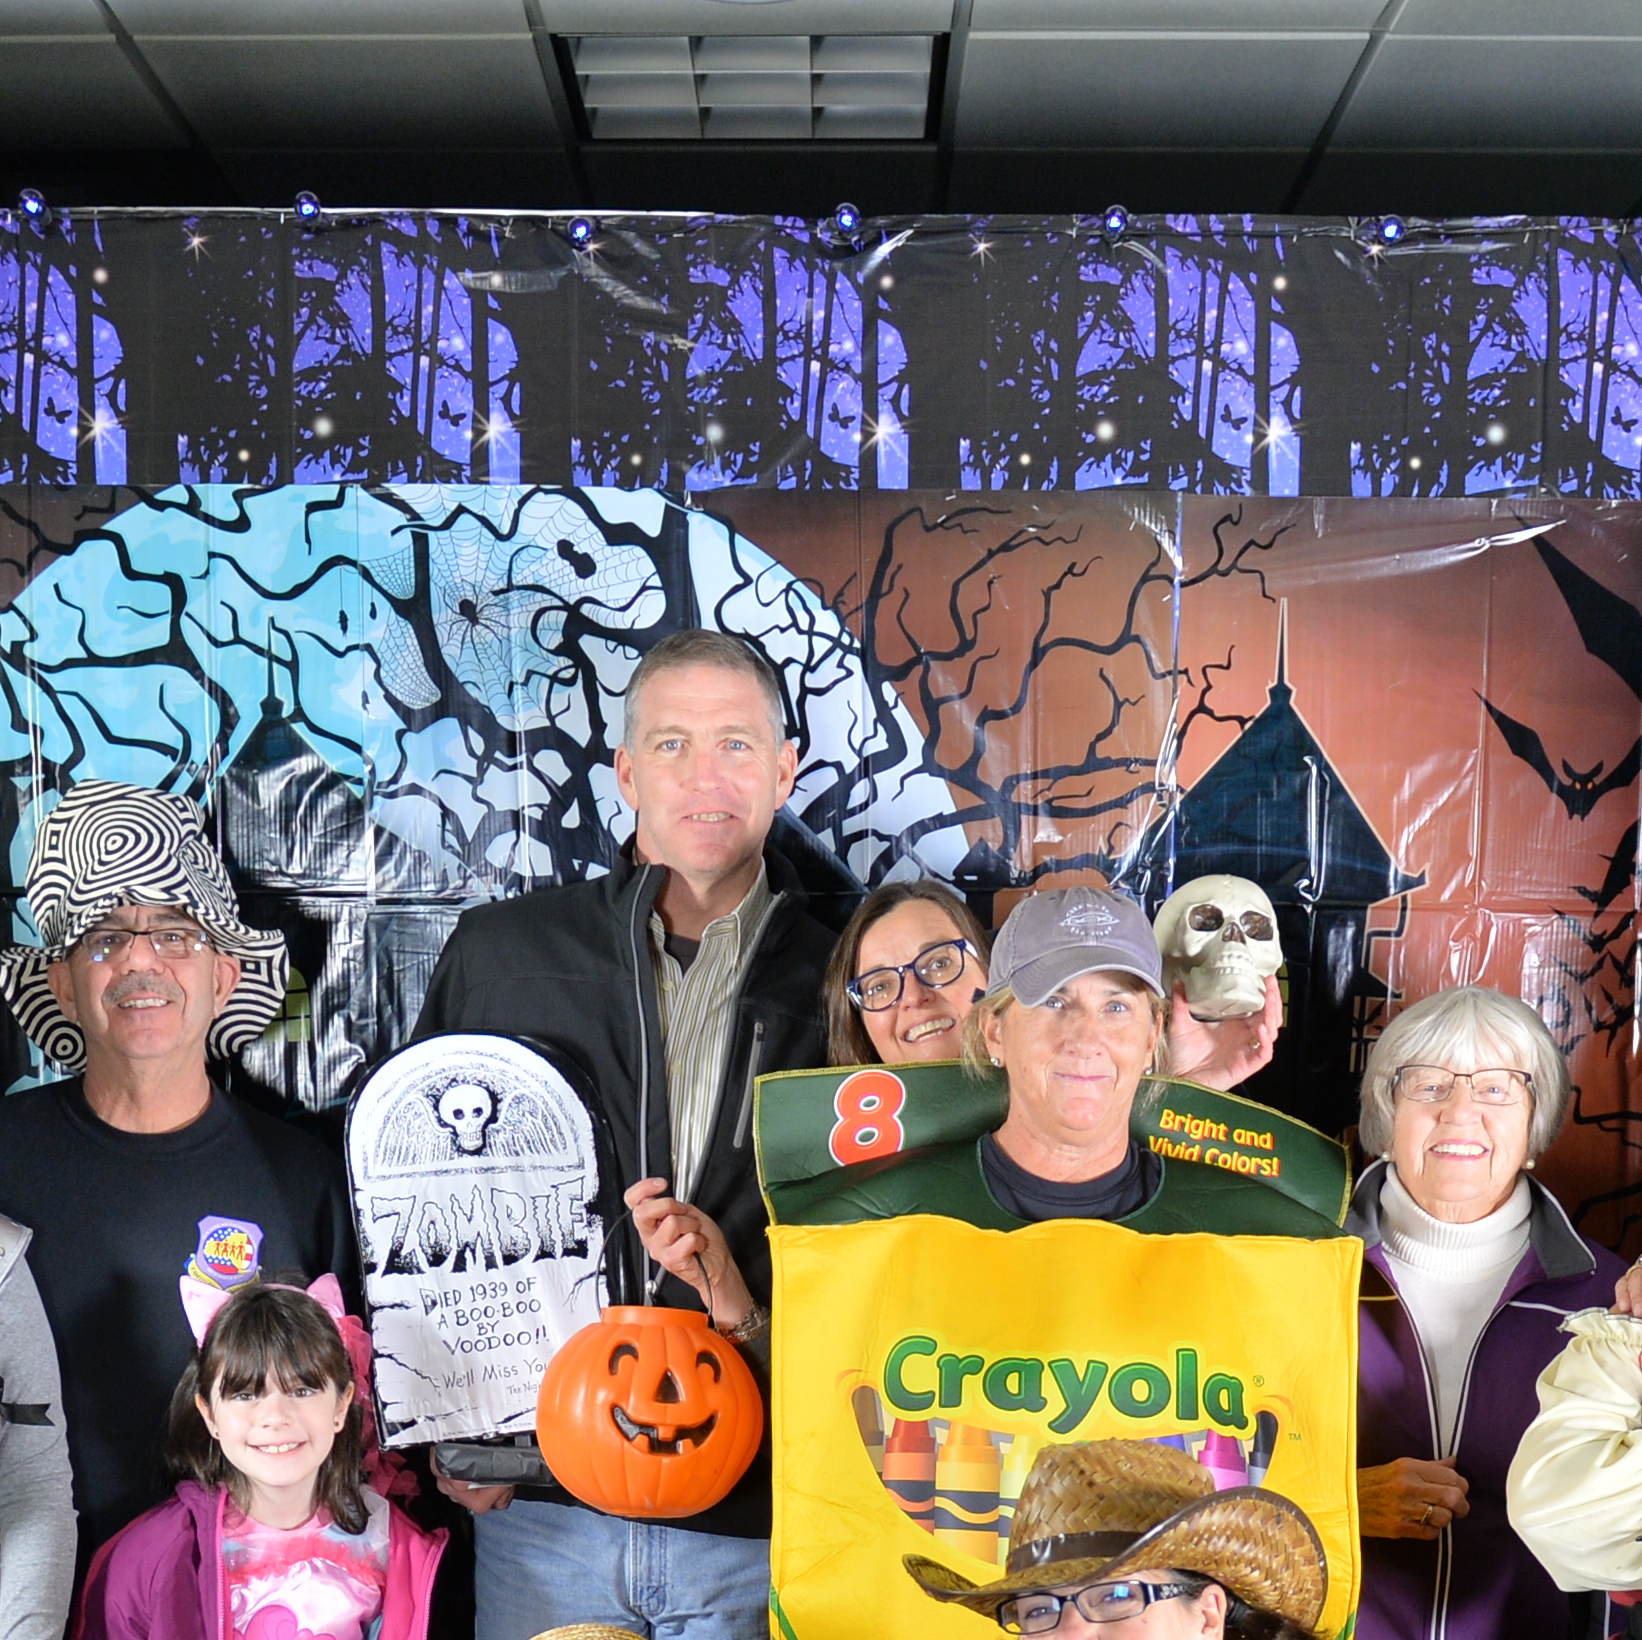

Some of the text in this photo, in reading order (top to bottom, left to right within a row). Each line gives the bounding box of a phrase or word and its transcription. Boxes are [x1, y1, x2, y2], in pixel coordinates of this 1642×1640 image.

[828, 1068, 906, 1167] 8
[1159, 1108, 1275, 1151] Bright and
[1148, 1135, 1281, 1177] Vivid Colors!
[370, 1175, 589, 1278] ZOMBIE
[419, 1277, 538, 1317] DIED 1939 OF
[437, 1298, 542, 1331] A BOO-BOO
[442, 1325, 550, 1356] VOODOO!!
[477, 1320, 500, 1337] BY
[442, 1369, 475, 1389] We'll
[482, 1364, 519, 1382] Miss
[883, 1335, 1249, 1435] Crayola
